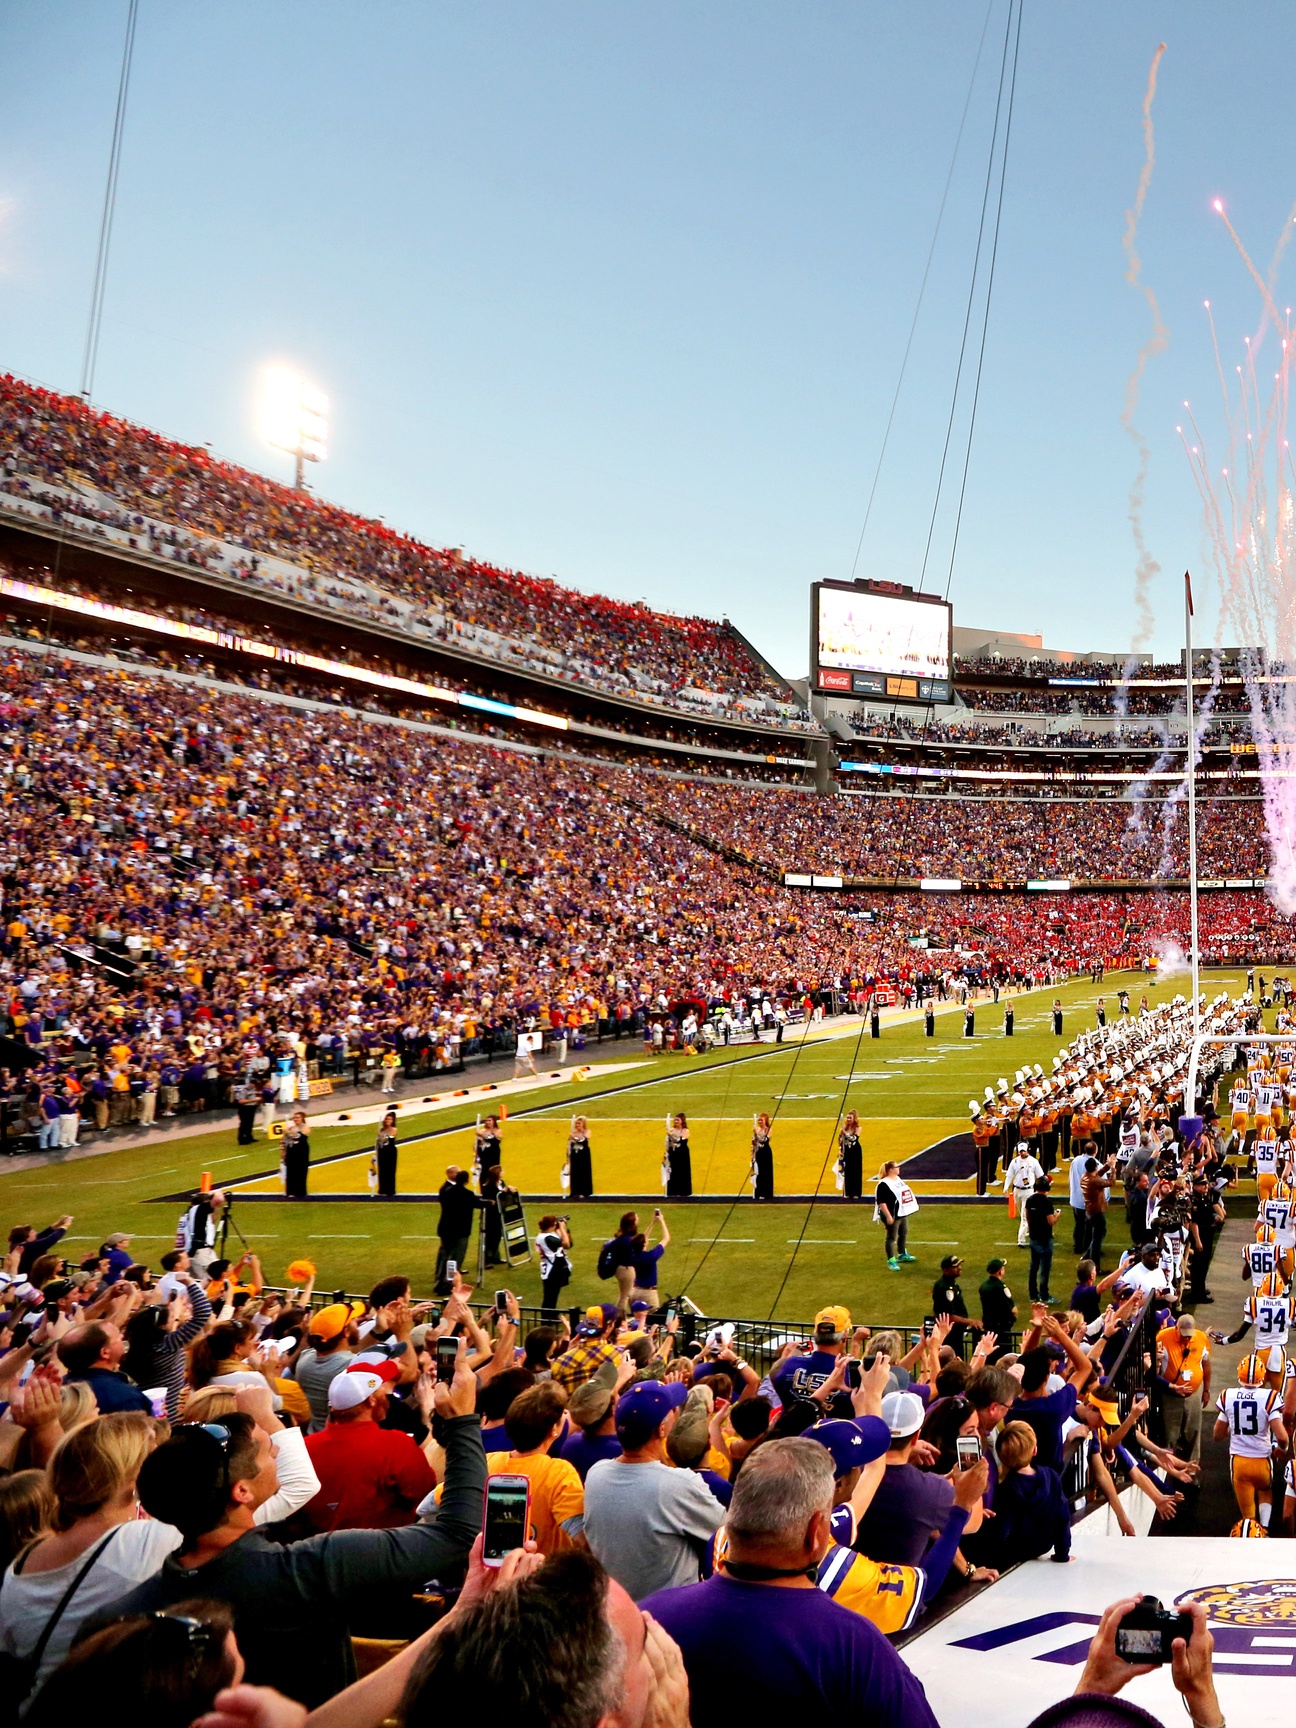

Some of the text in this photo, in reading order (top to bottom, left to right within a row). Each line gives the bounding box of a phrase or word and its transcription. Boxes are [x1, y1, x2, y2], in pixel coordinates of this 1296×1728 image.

[868, 578, 903, 594] LSU
[878, 994, 886, 1002] G
[1248, 1050, 1256, 1059] 24
[1281, 1052, 1292, 1062] 50
[1253, 1072, 1262, 1083] 17
[1237, 1092, 1248, 1104] 40
[1263, 1092, 1270, 1104] 11
[273, 1125, 283, 1135] G
[1258, 1145, 1274, 1161] 35
[1266, 1207, 1289, 1229] 57
[1251, 1252, 1273, 1274] 86
[1259, 1307, 1286, 1333] 34
[1236, 1391, 1255, 1401] CLISE
[1232, 1400, 1259, 1436] 13
